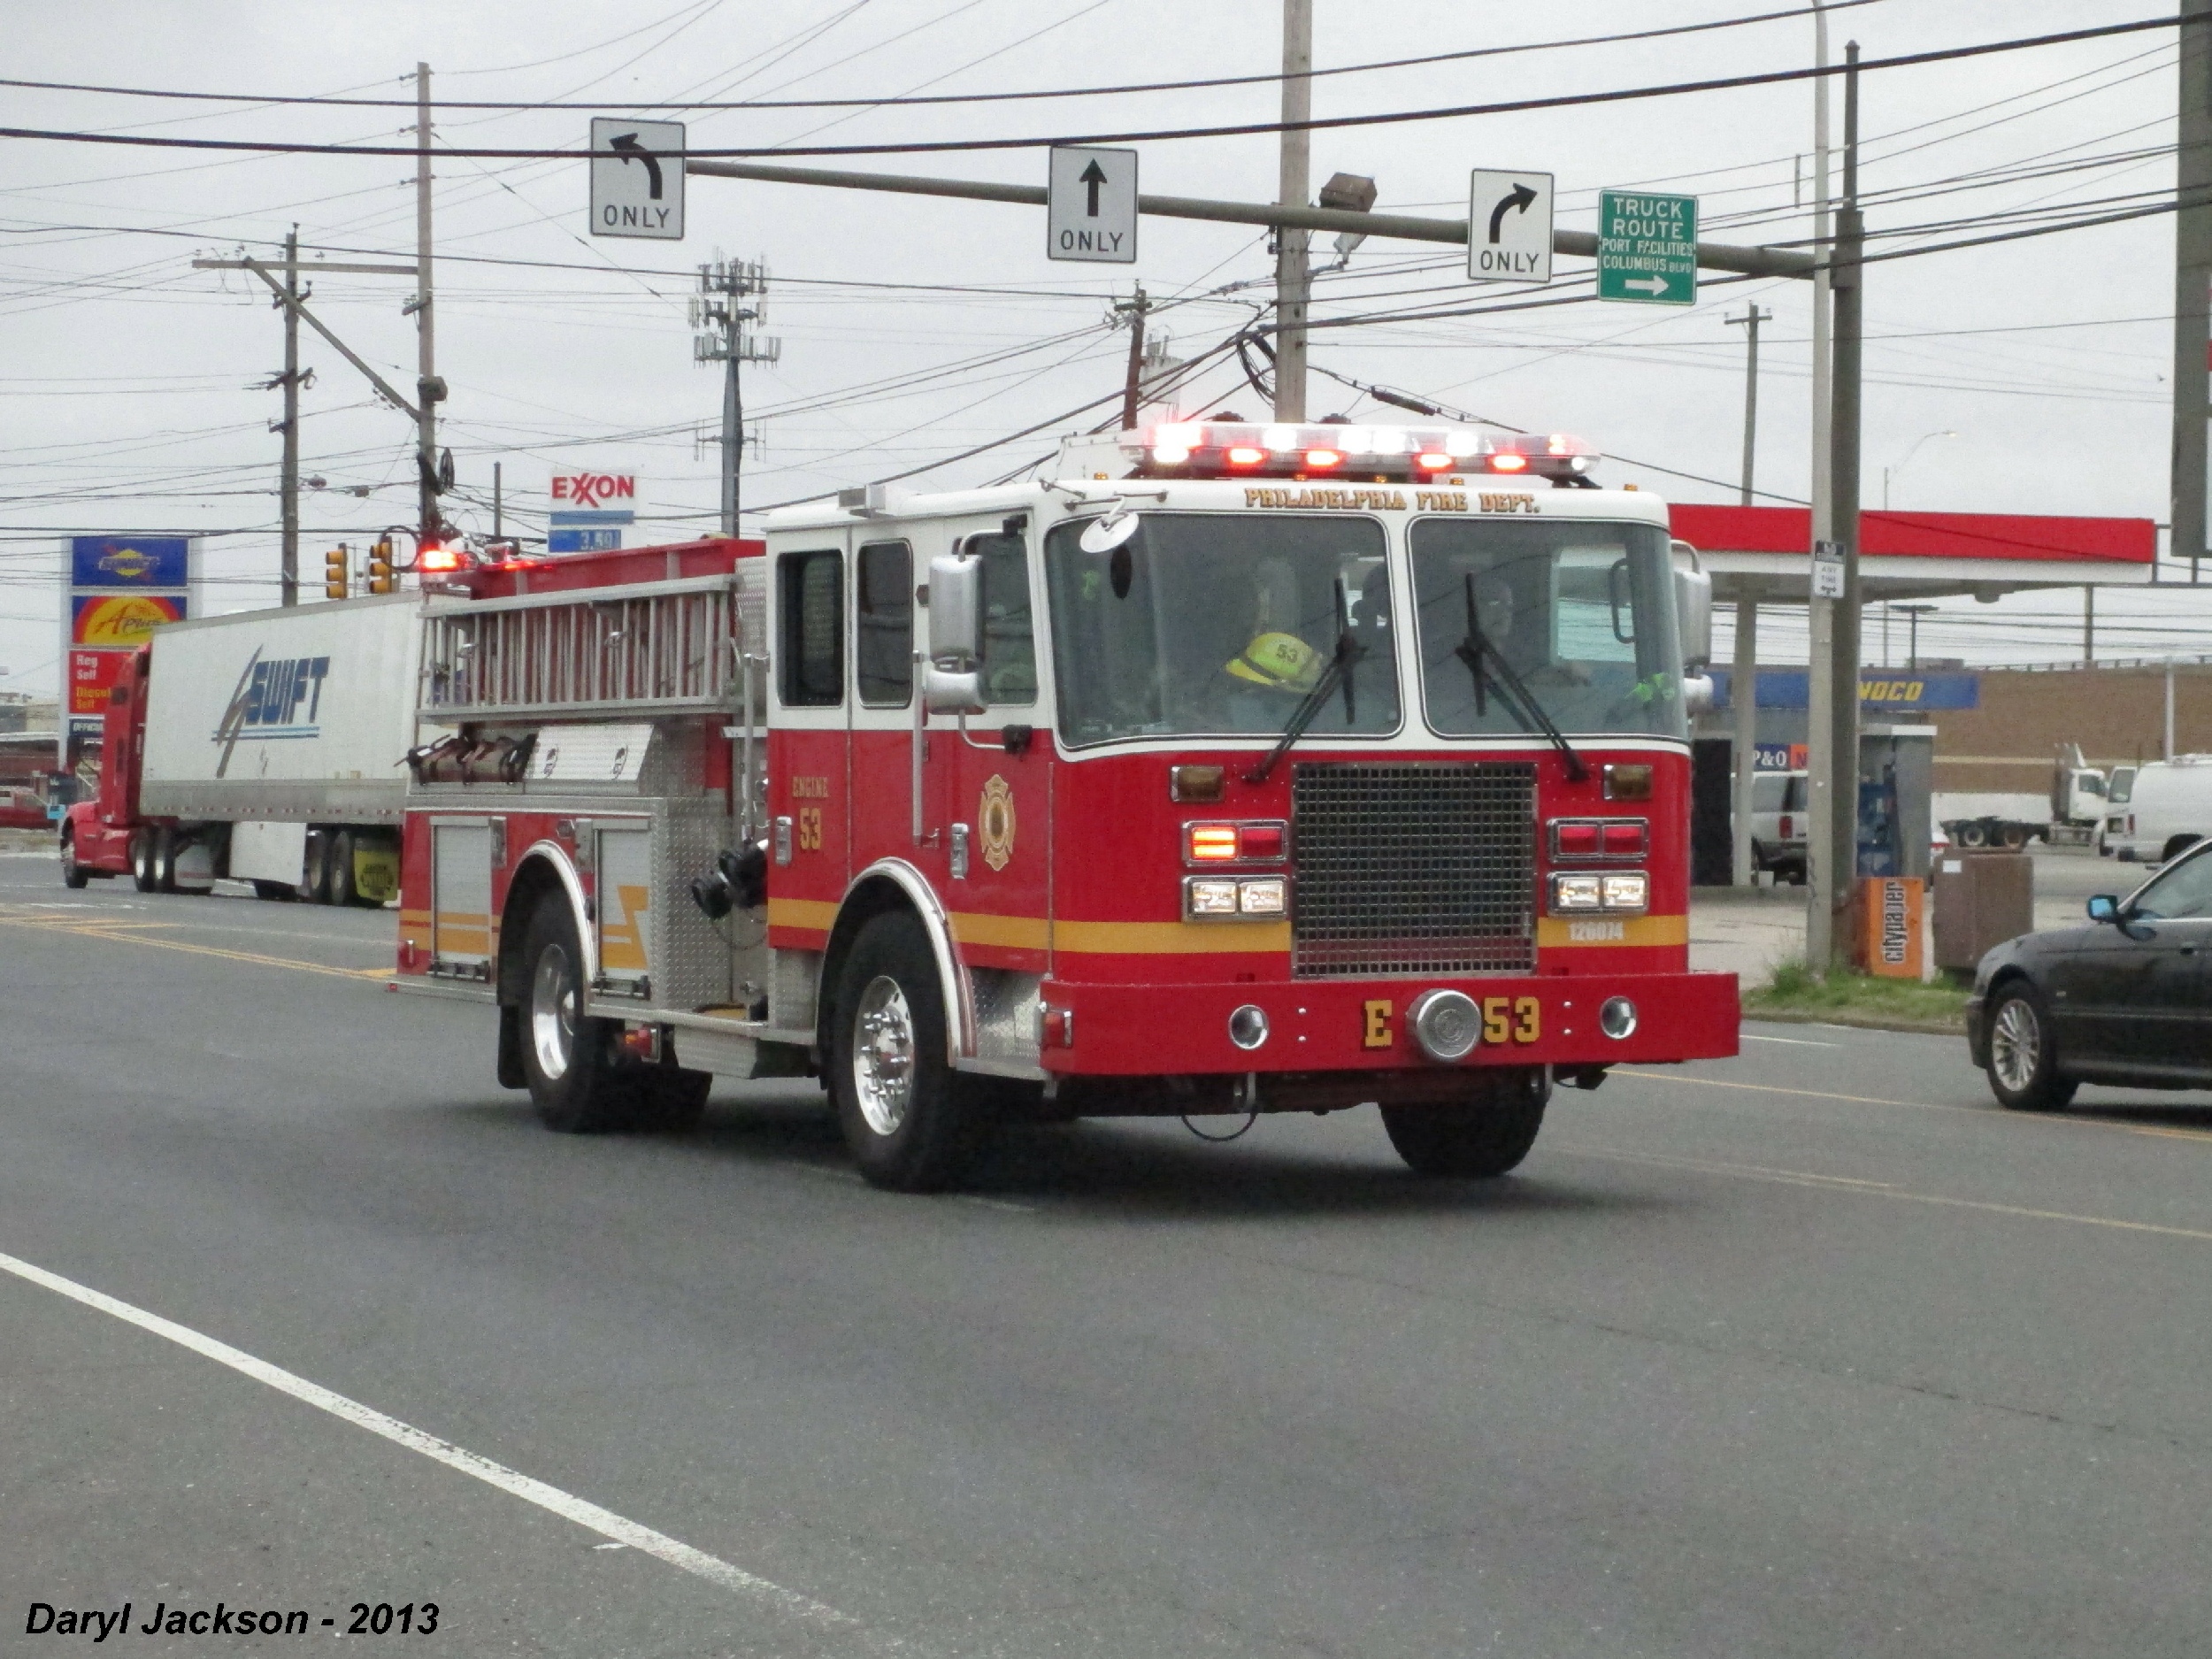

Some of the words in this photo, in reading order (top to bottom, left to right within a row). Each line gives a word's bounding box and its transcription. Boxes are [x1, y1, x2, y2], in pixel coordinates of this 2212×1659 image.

[603, 204, 670, 228] ONLY
[1613, 197, 1684, 219] TRUCK
[1060, 228, 1123, 252] ONLY
[1613, 218, 1685, 240] ROUTE
[1601, 237, 1631, 252] PORT
[1480, 250, 1540, 273] ONLY
[1602, 255, 1667, 272] COLUMBUS
[551, 472, 634, 508] EXXON
[1244, 488, 1407, 511] PHILADELPHIA
[1416, 491, 1469, 512] FIRE
[1479, 492, 1541, 514] DEPT.
[76, 655, 98, 670] Reg
[1276, 643, 1298, 664] 53
[76, 669, 98, 680] Self
[793, 776, 828, 798] ENGINE
[799, 807, 821, 849] 53
[1365, 1000, 1393, 1047] E
[1484, 996, 1540, 1043] 53
